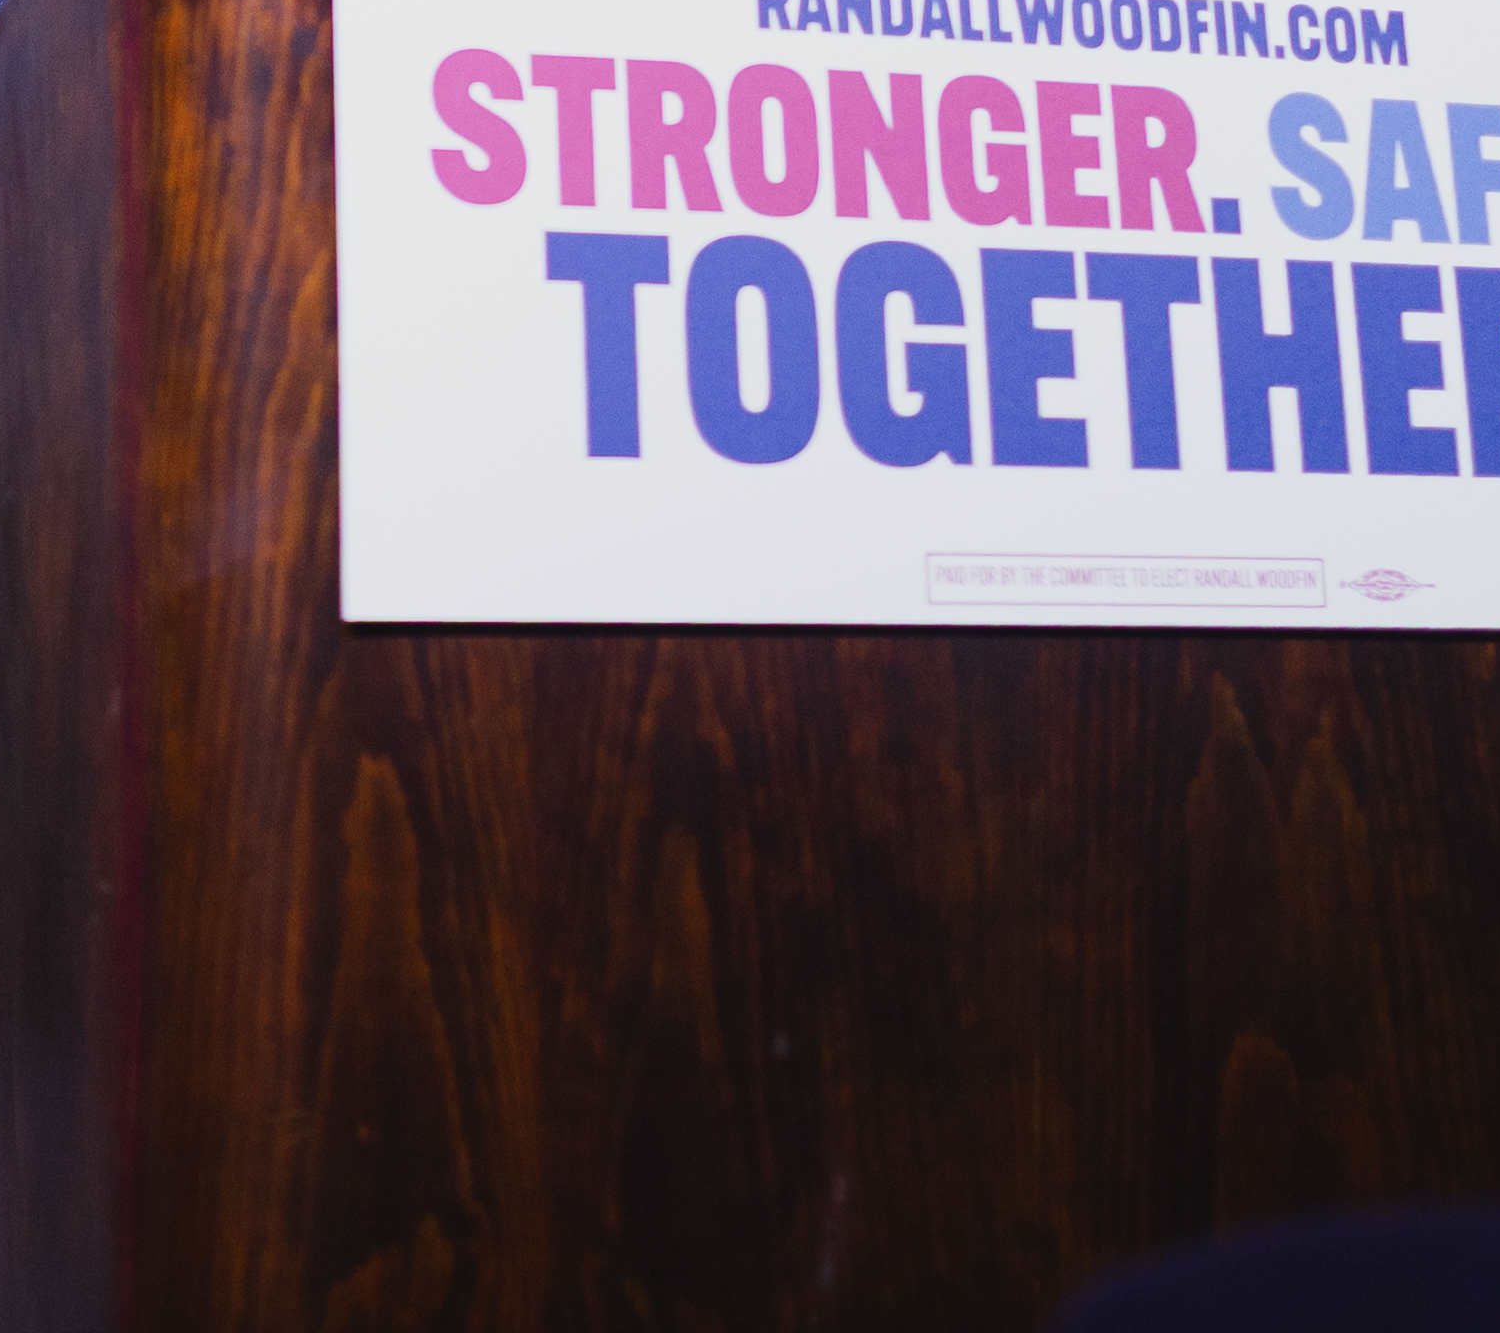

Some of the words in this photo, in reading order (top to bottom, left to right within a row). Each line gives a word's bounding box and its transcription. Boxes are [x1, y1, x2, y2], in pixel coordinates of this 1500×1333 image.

[431, 48, 1243, 235] STRONGER.
[936, 565, 968, 584] PAID
[971, 566, 998, 584] FOR
[1001, 566, 1016, 584] BY
[1022, 566, 1046, 585] THE
[1050, 566, 1128, 587] COMMITTEE
[1151, 567, 1192, 588] ELECT
[1194, 568, 1253, 589] RANDALL
[1257, 569, 1317, 589] WOODFIN
